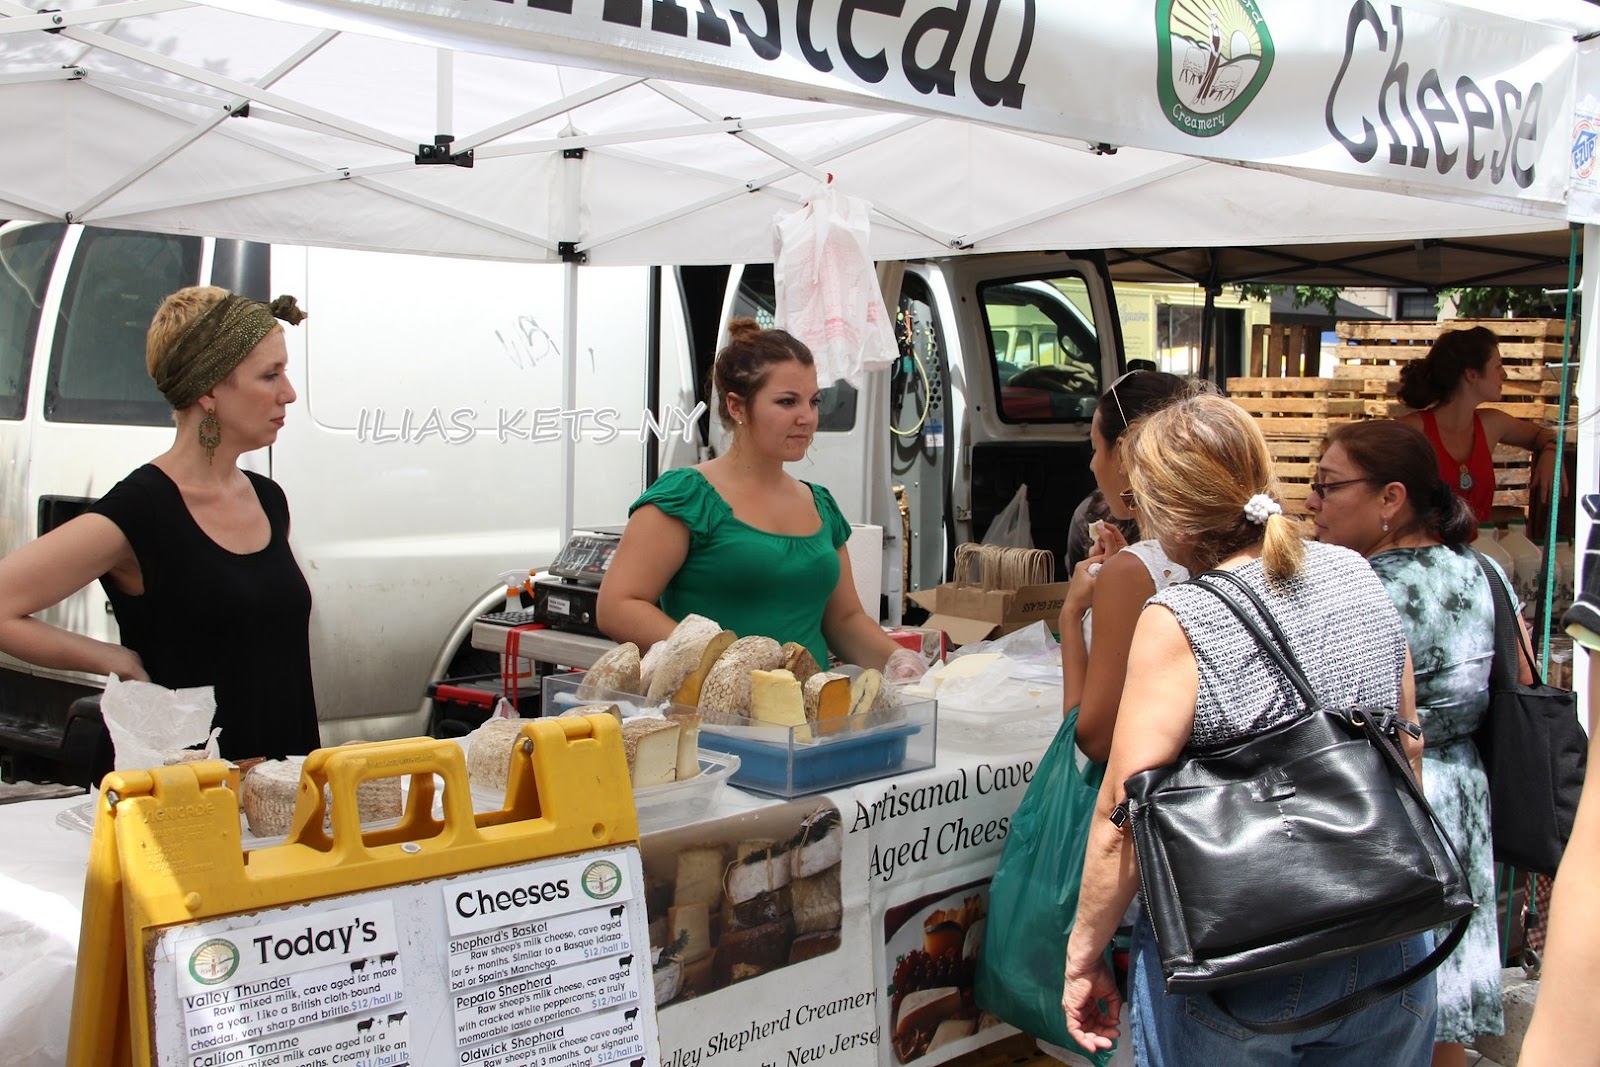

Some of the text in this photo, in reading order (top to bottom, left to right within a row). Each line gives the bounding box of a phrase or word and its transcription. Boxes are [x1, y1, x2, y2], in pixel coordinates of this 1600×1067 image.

[1325, 0, 1544, 189] Cheese
[1172, 103, 1225, 131] Creamery
[849, 760, 1034, 834] Artisanal Cave
[868, 816, 1012, 882] Aged Chees
[456, 879, 571, 919] Cheeses
[253, 917, 378, 965] Today's
[450, 922, 548, 953] Shepherd's Basket
[470, 920, 622, 960] Raw sheep's milk cheese, cave aged
[584, 941, 629, 958] $12/half lb
[451, 968, 463, 978] for
[465, 965, 475, 974] 5+
[477, 957, 510, 971] months.
[513, 949, 542, 962] Similar
[545, 947, 553, 955] to
[563, 938, 594, 951] Basque
[452, 960, 558, 990] bal or Spain's Manchego.
[186, 990, 230, 1009] Valley
[234, 976, 292, 998] Thunder
[213, 968, 398, 1017] Raw mixed milk, cave aged for more
[352, 990, 403, 1011] $12/half lb
[456, 974, 552, 1009] Pepato Shepherd
[458, 1021, 477, 1032] with
[479, 1011, 514, 1026] cracked
[517, 1004, 541, 1017] white
[598, 987, 604, 995] a
[606, 982, 625, 993] truly
[477, 969, 630, 1015] Raw sheep's milk cheese, cave aged
[592, 990, 638, 1009] $12/half lb
[190, 983, 381, 1038] than a year. Like a British cloth-bound
[191, 1005, 351, 1051] cheddar, very sharp and brittle.
[459, 1006, 582, 1045] memorable taste experience.
[193, 1037, 300, 1067] Califon Tomme
[283, 1050, 304, 1062] milk
[308, 1044, 333, 1056] cave
[335, 1037, 360, 1050] aged
[363, 1034, 376, 1044] for
[332, 1048, 371, 1064] Creamy
[374, 1044, 391, 1055] like
[393, 1041, 407, 1050] an
[400, 1051, 409, 1061] lb
[461, 1027, 565, 1063] Oldwick Shepherd
[483, 1057, 503, 1067] Raw
[505, 1049, 536, 1063] sheep's
[538, 1043, 557, 1054] milk
[559, 1037, 588, 1048] cheese
[590, 1030, 611, 1041] cave
[612, 1023, 633, 1035] aged
[541, 1057, 547, 1066] 3
[548, 1050, 581, 1065] months.
[583, 1044, 599, 1054] Our
[601, 1034, 639, 1051] signature
[597, 1044, 643, 1063] $12/half lb
[662, 1047, 702, 1067] alley
[705, 1009, 791, 1058] Shepherd
[785, 1044, 825, 1067] New
